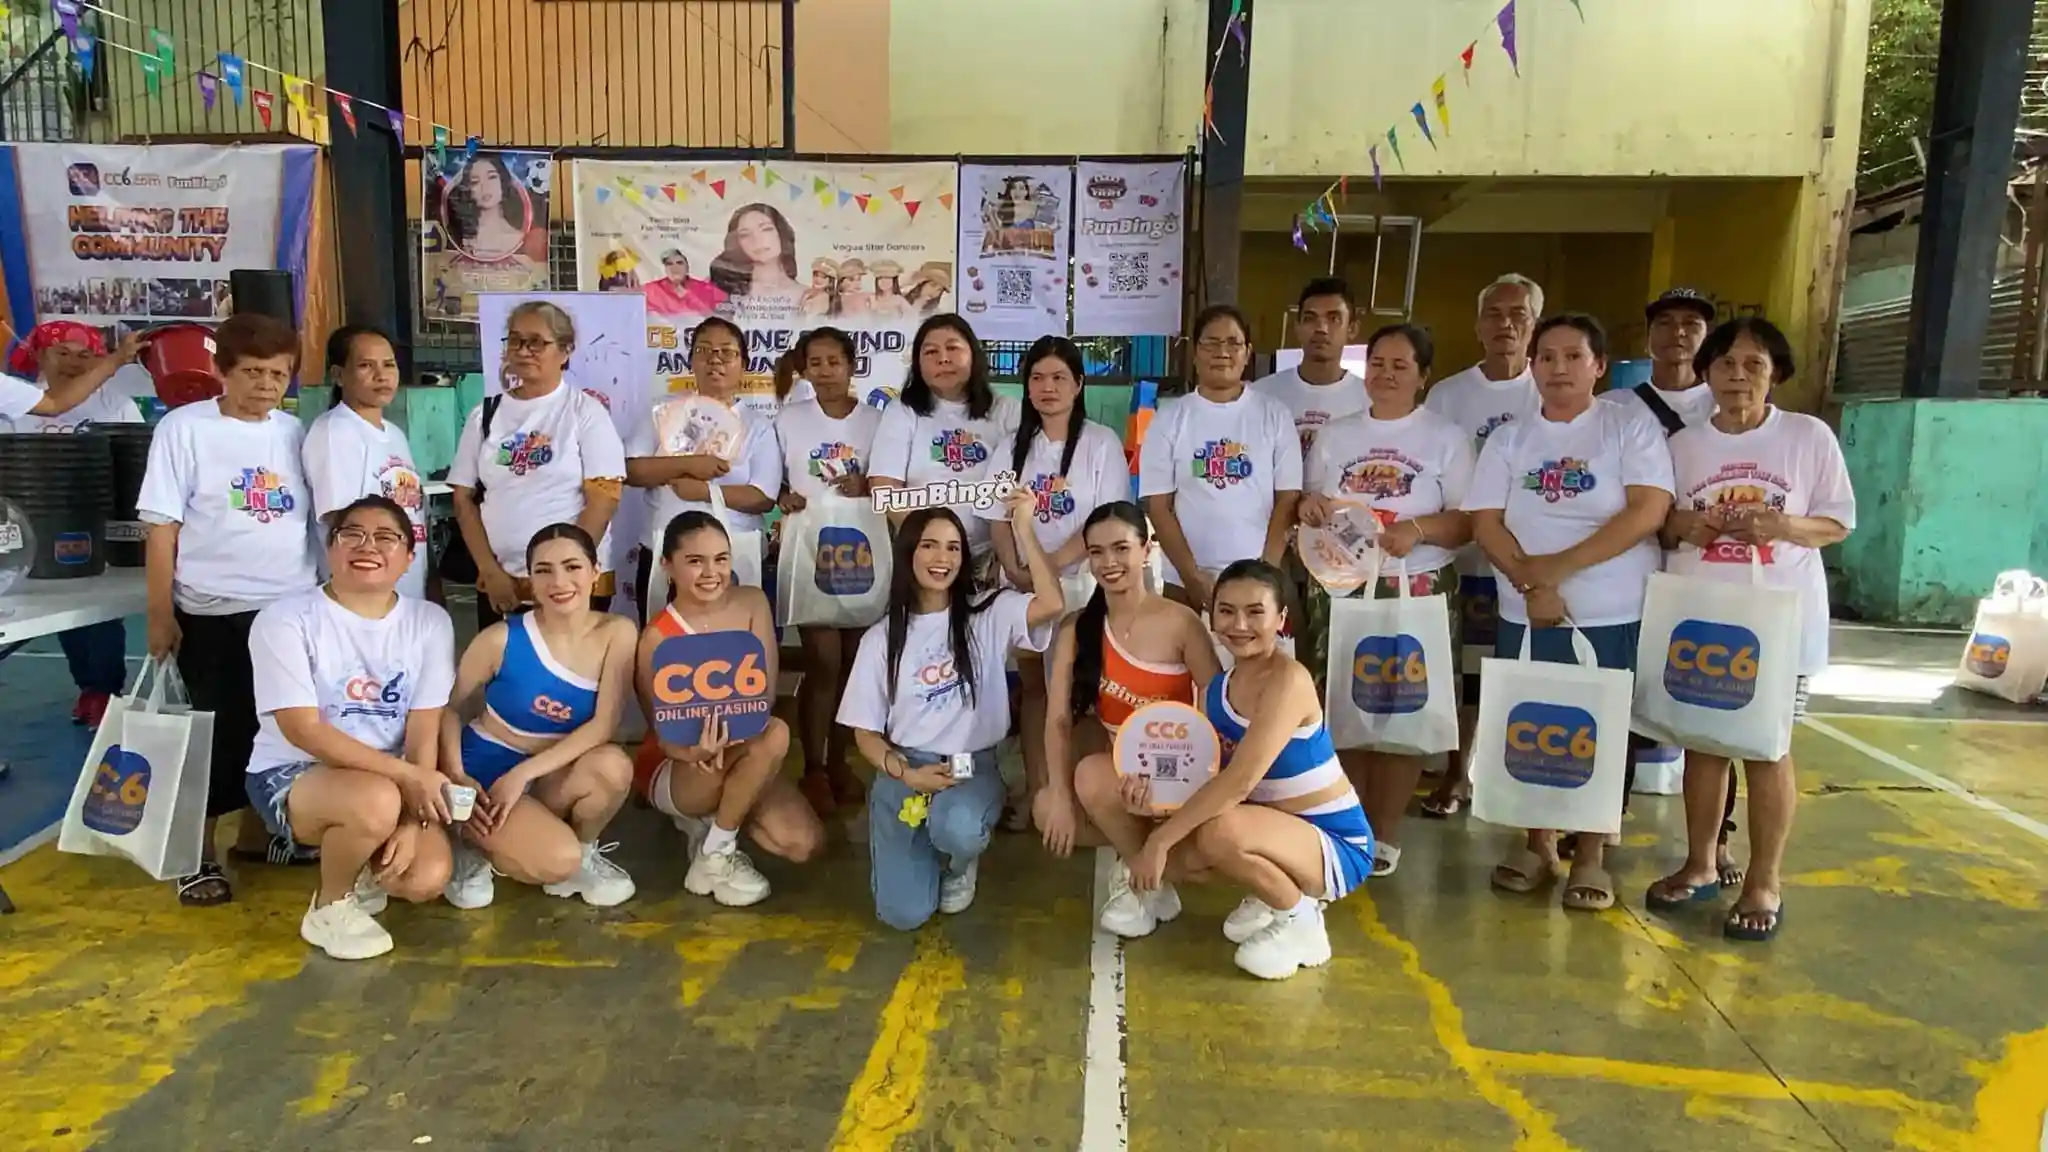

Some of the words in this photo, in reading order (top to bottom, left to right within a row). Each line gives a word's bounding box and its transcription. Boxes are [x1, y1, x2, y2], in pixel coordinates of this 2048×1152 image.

[178, 207, 229, 234] THE
[1081, 216, 1179, 239] FunBingo
[71, 234, 228, 262] COMMUNITY
[1192, 458, 1252, 477] BINGO
[229, 487, 295, 510] BINGO
[873, 477, 1016, 511] FunBingo
[1354, 650, 1427, 684] CC6
[1669, 639, 1758, 680] CC6
[346, 671, 404, 703] CC6
[653, 652, 767, 704] CC6
[533, 695, 572, 721] CC6
[656, 707, 709, 722] ONLINE
[714, 701, 768, 716] CASINO
[1145, 721, 1189, 739] CC6
[1507, 721, 1596, 759] CC6
